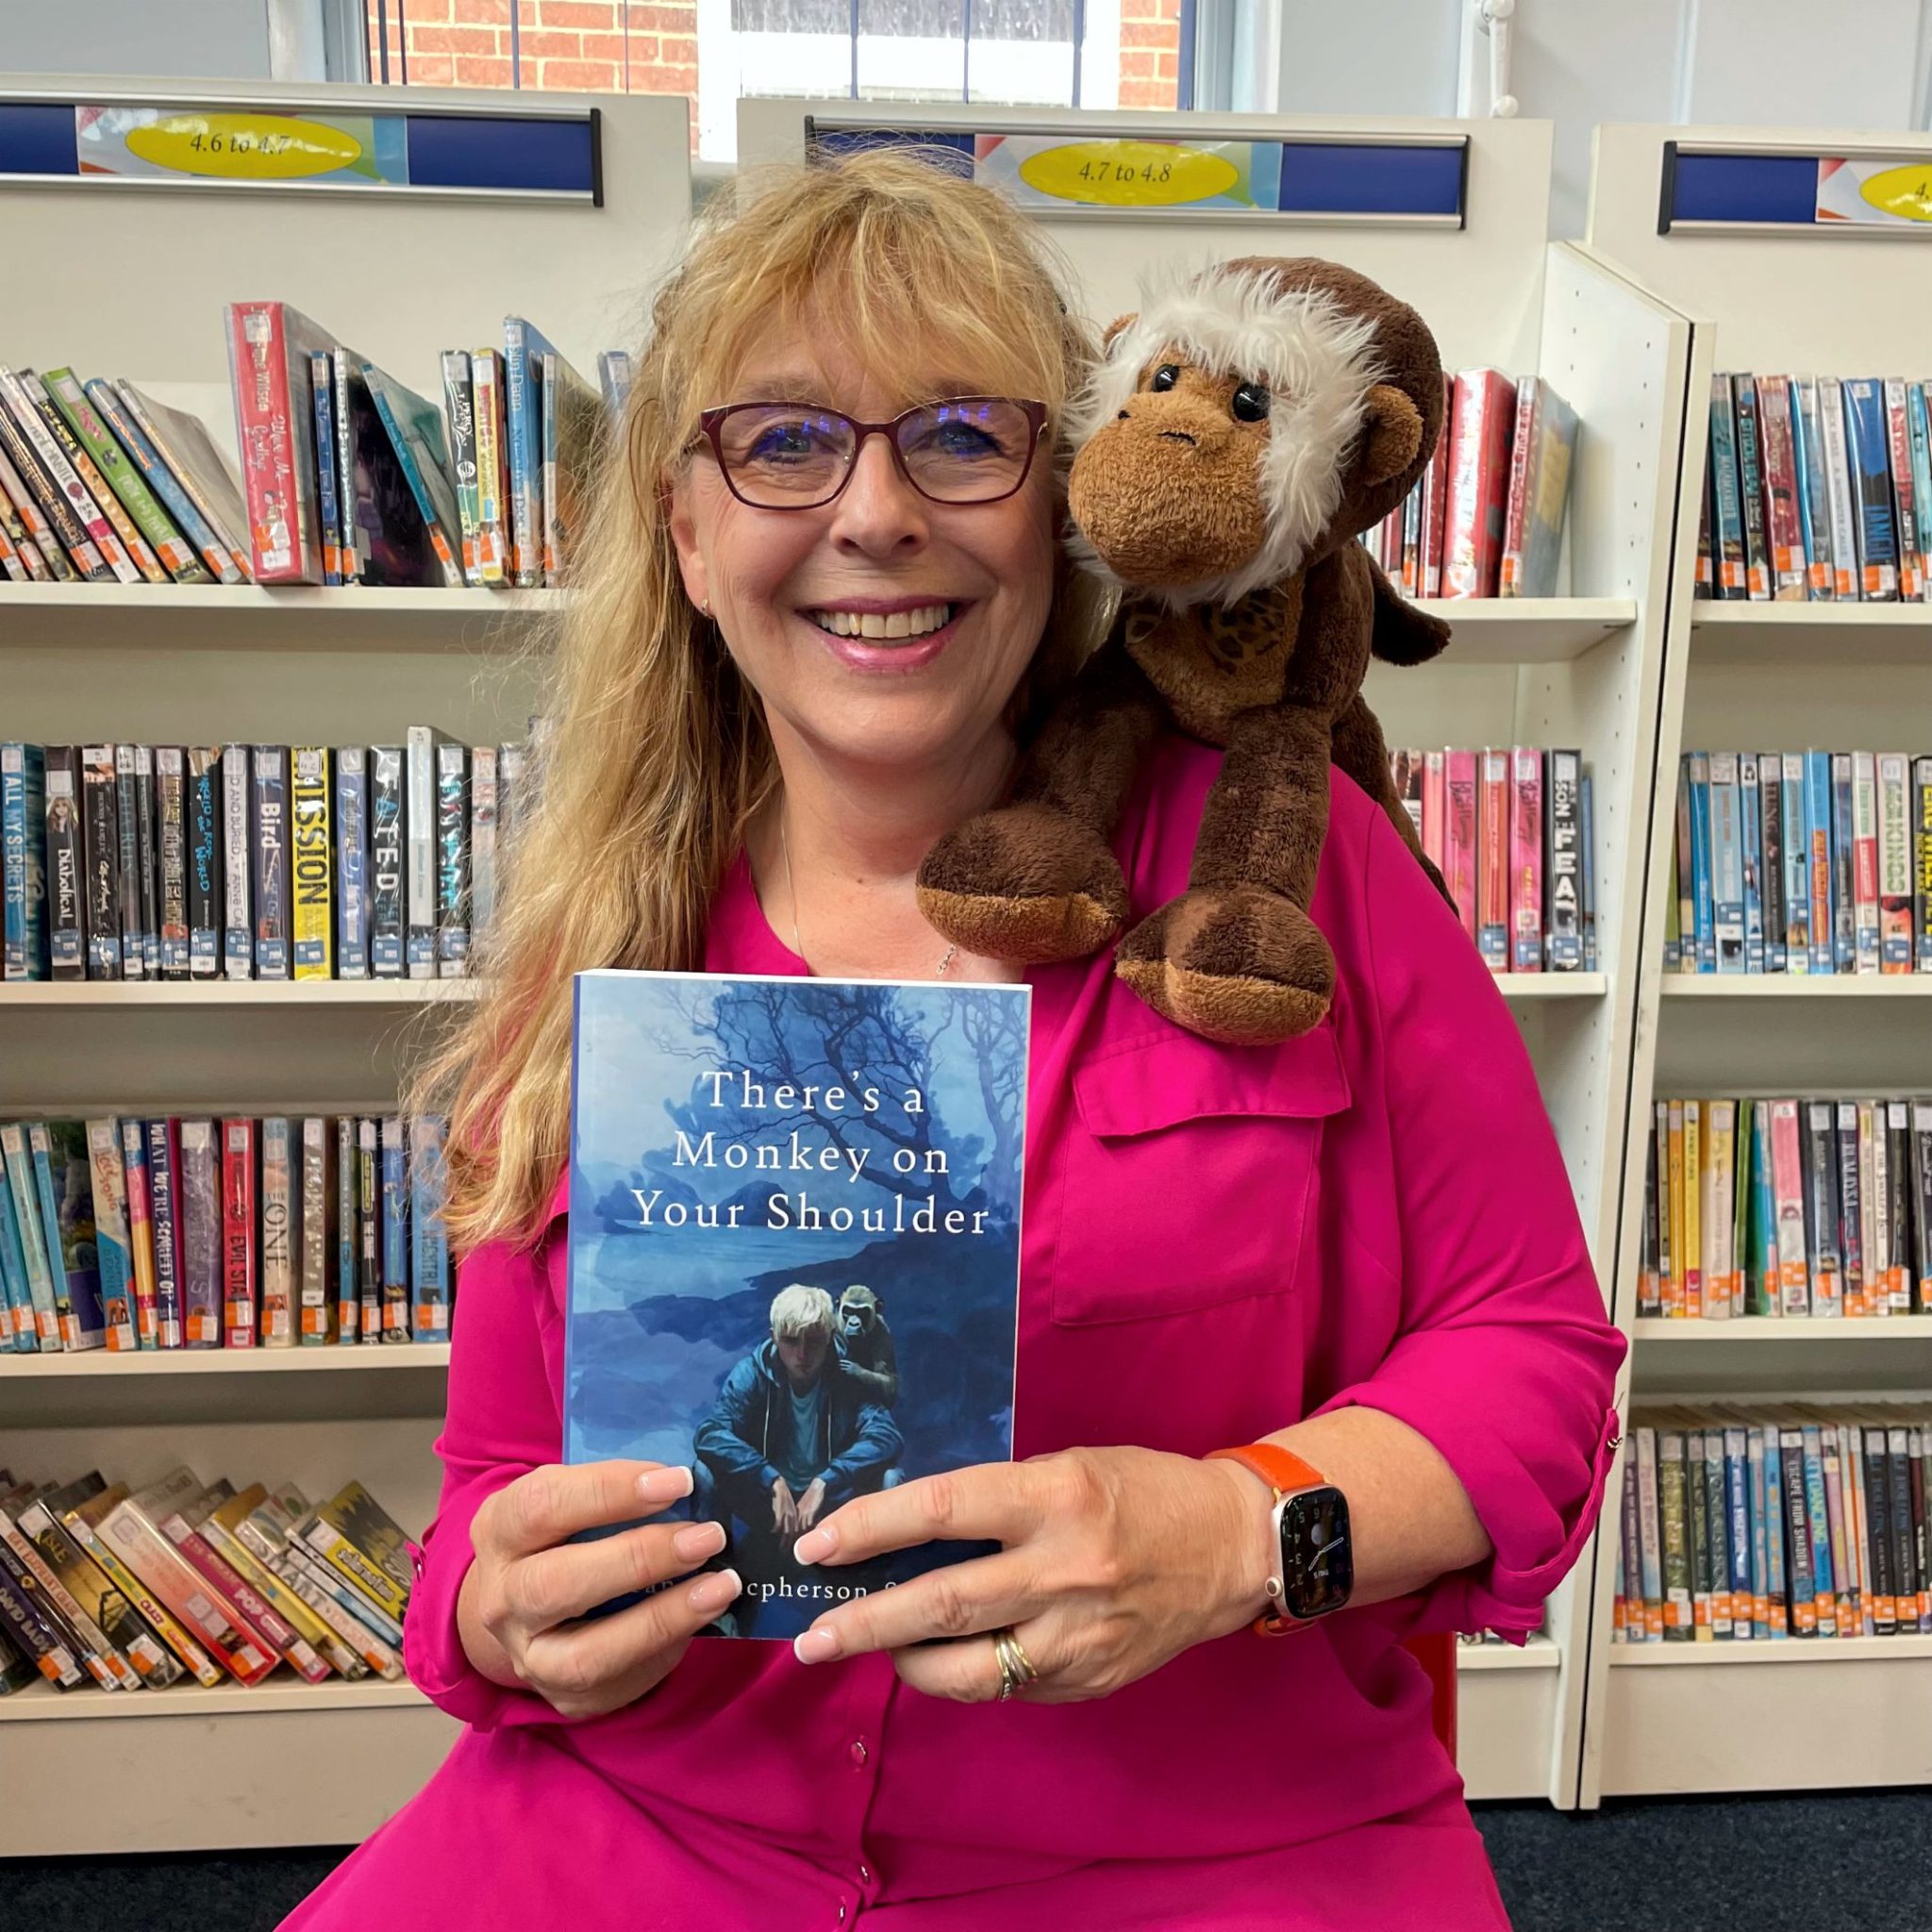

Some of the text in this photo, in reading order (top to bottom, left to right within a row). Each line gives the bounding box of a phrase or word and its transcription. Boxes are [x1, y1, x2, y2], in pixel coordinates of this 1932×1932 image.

[190, 132, 290, 155] 4.6 to 4.7
[1078, 161, 1172, 183] 4.7 to 4.8
[255, 373, 269, 411] Wilson
[511, 374, 523, 411] Dann
[230, 789, 242, 813] AND
[1555, 782, 1570, 817] SON
[1764, 781, 1779, 834] TUNG
[5, 776, 25, 903] ALL MY SECRETS
[261, 803, 282, 851] Bird
[295, 762, 327, 905] MISSION
[58, 848, 75, 920] Diabolical
[195, 847, 210, 891] WORLD
[702, 1071, 925, 1113] There's a
[152, 1124, 167, 1166] WHAT
[673, 1131, 951, 1181] Monkey on
[99, 1178, 120, 1211] SONG
[153, 1172, 170, 1218] WE'RE
[632, 1189, 991, 1235] Your Shoulder
[157, 1221, 172, 1276] SCARED
[265, 1203, 287, 1270] ONE
[231, 1236, 246, 1295] EVIL STA
[1788, 1460, 1807, 1568] ESCAPE FROM SHADOW
[738, 1575, 867, 1603] cpherson
